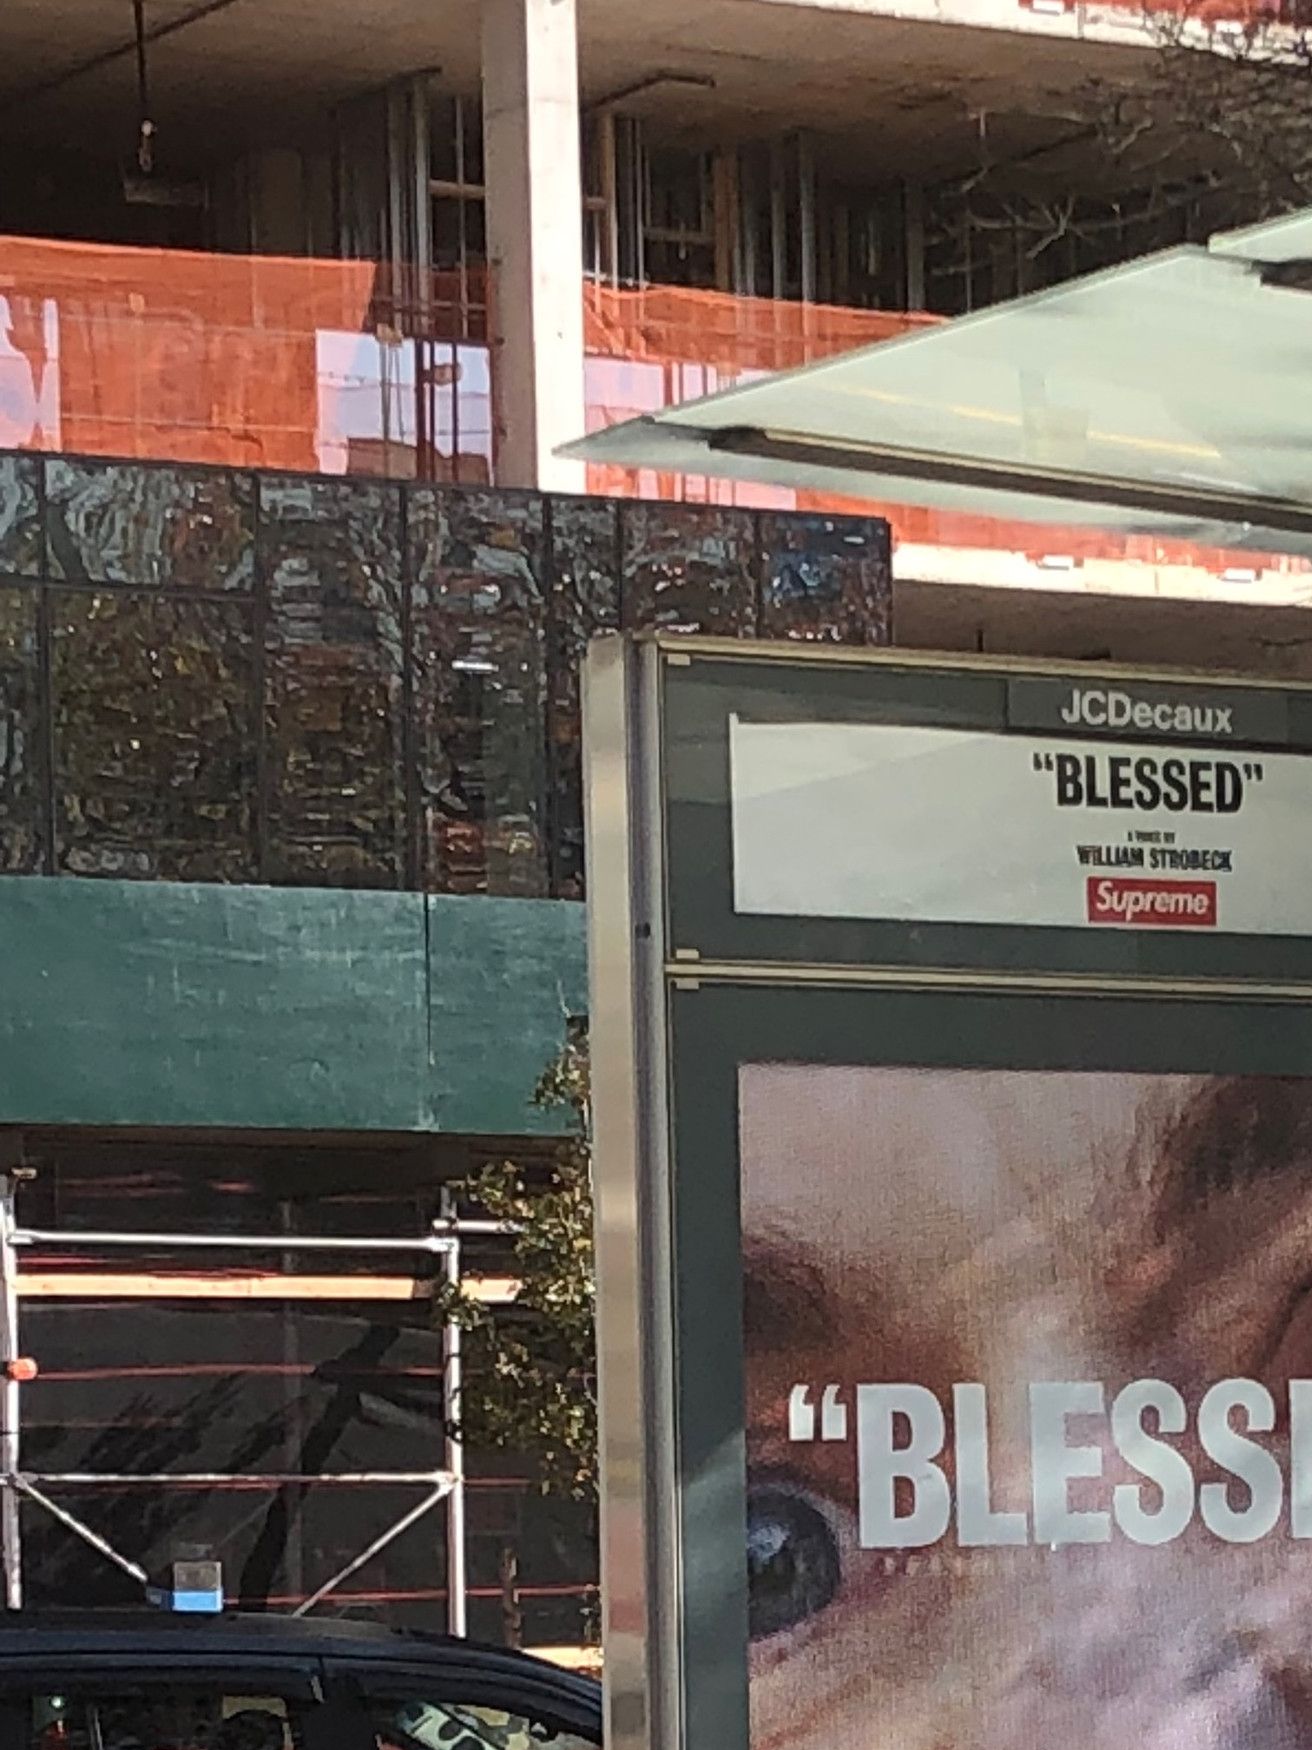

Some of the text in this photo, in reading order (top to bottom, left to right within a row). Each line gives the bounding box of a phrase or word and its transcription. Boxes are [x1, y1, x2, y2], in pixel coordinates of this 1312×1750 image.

[1061, 689, 1233, 734] JCDecaux
[1033, 753, 1263, 813] “BLESSED”
[1076, 844, 1144, 868] WILLIAM
[1096, 881, 1209, 922] Supreme
